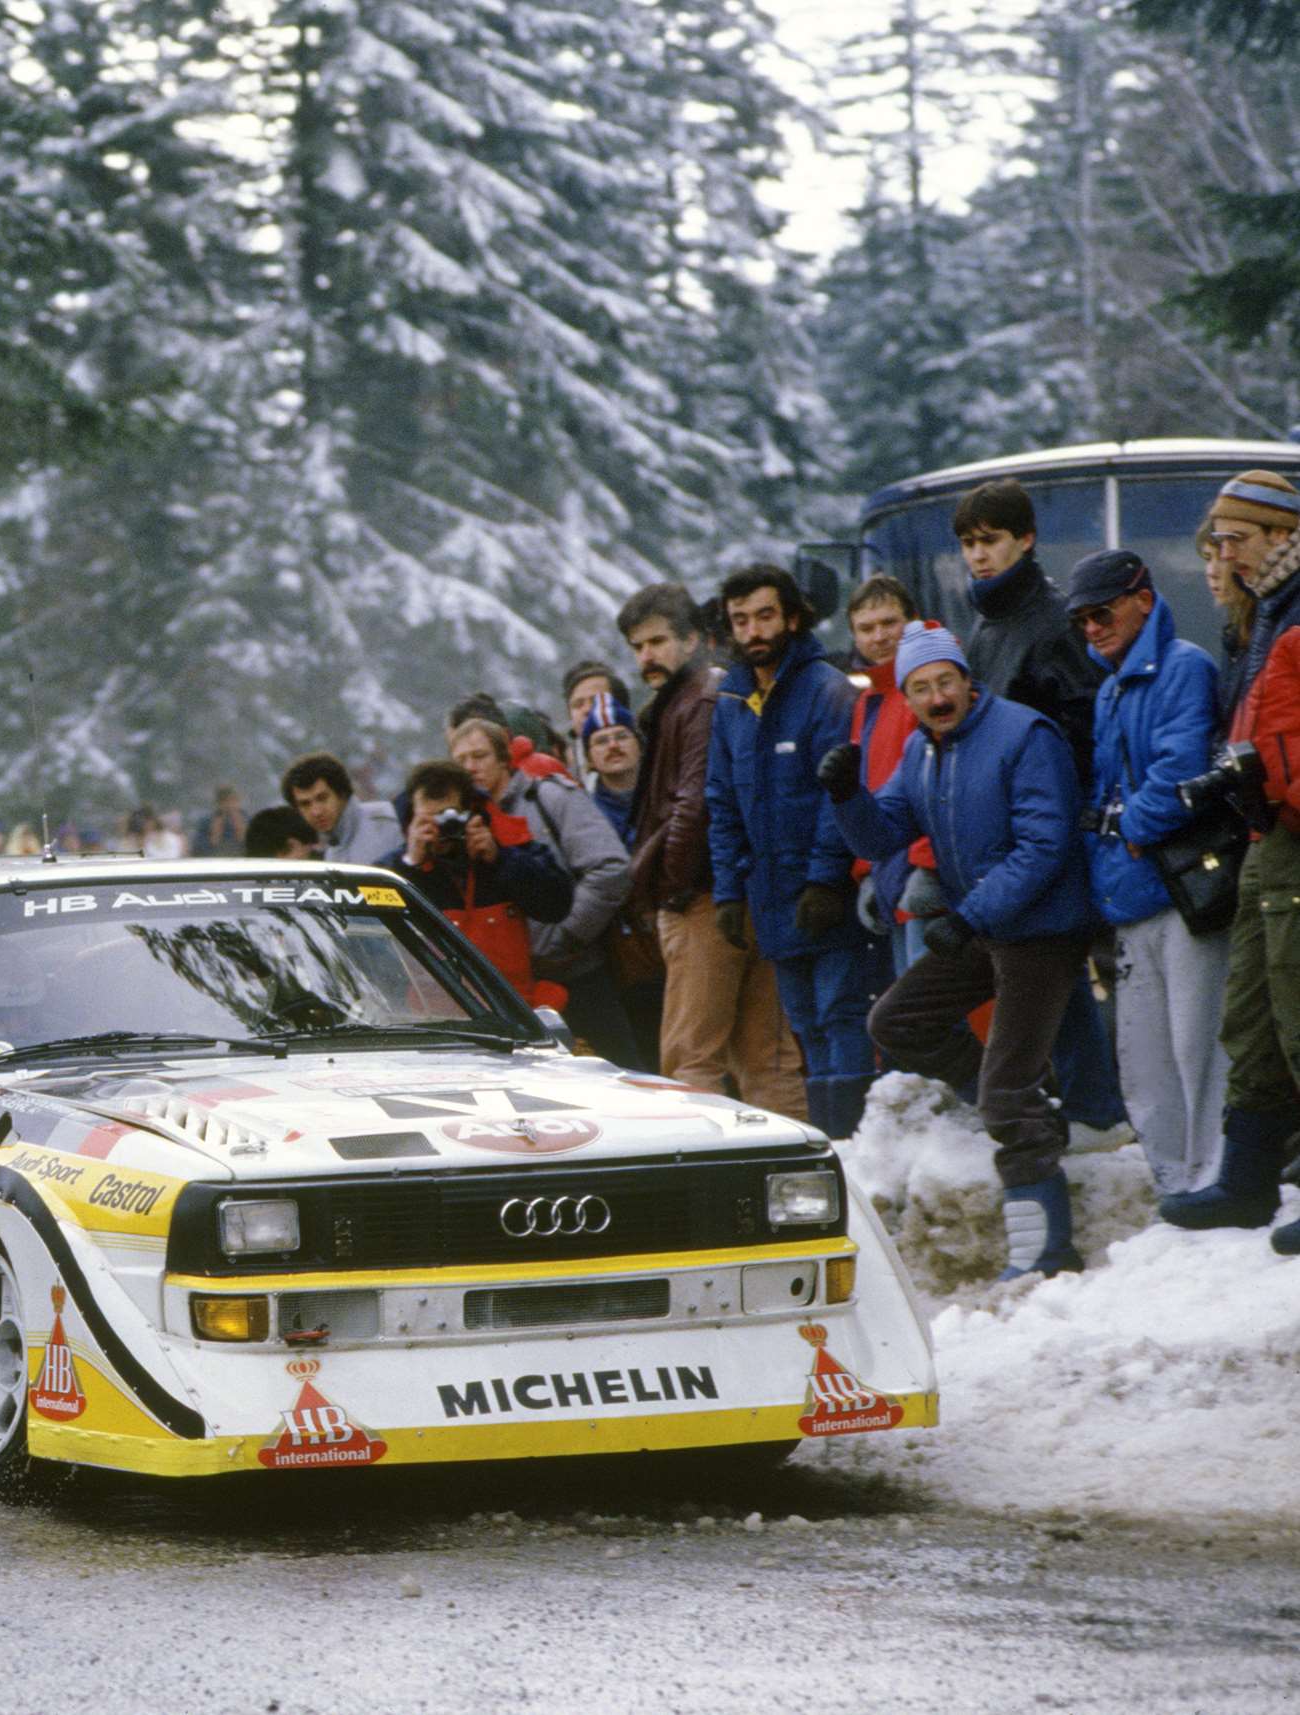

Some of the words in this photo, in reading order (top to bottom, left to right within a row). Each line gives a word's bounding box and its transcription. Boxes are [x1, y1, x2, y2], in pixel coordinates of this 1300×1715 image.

[24, 895, 98, 917] HB
[112, 889, 226, 909] Audi
[231, 887, 364, 905] TEAM
[39, 1156, 84, 1185] Sport
[88, 1172, 167, 1216] Castrol
[44, 1343, 72, 1394] HB
[437, 1366, 720, 1419] MICHELIN
[806, 1372, 876, 1414] HB
[280, 1405, 355, 1446] HB
[811, 1411, 891, 1433] international
[274, 1446, 371, 1466] international
